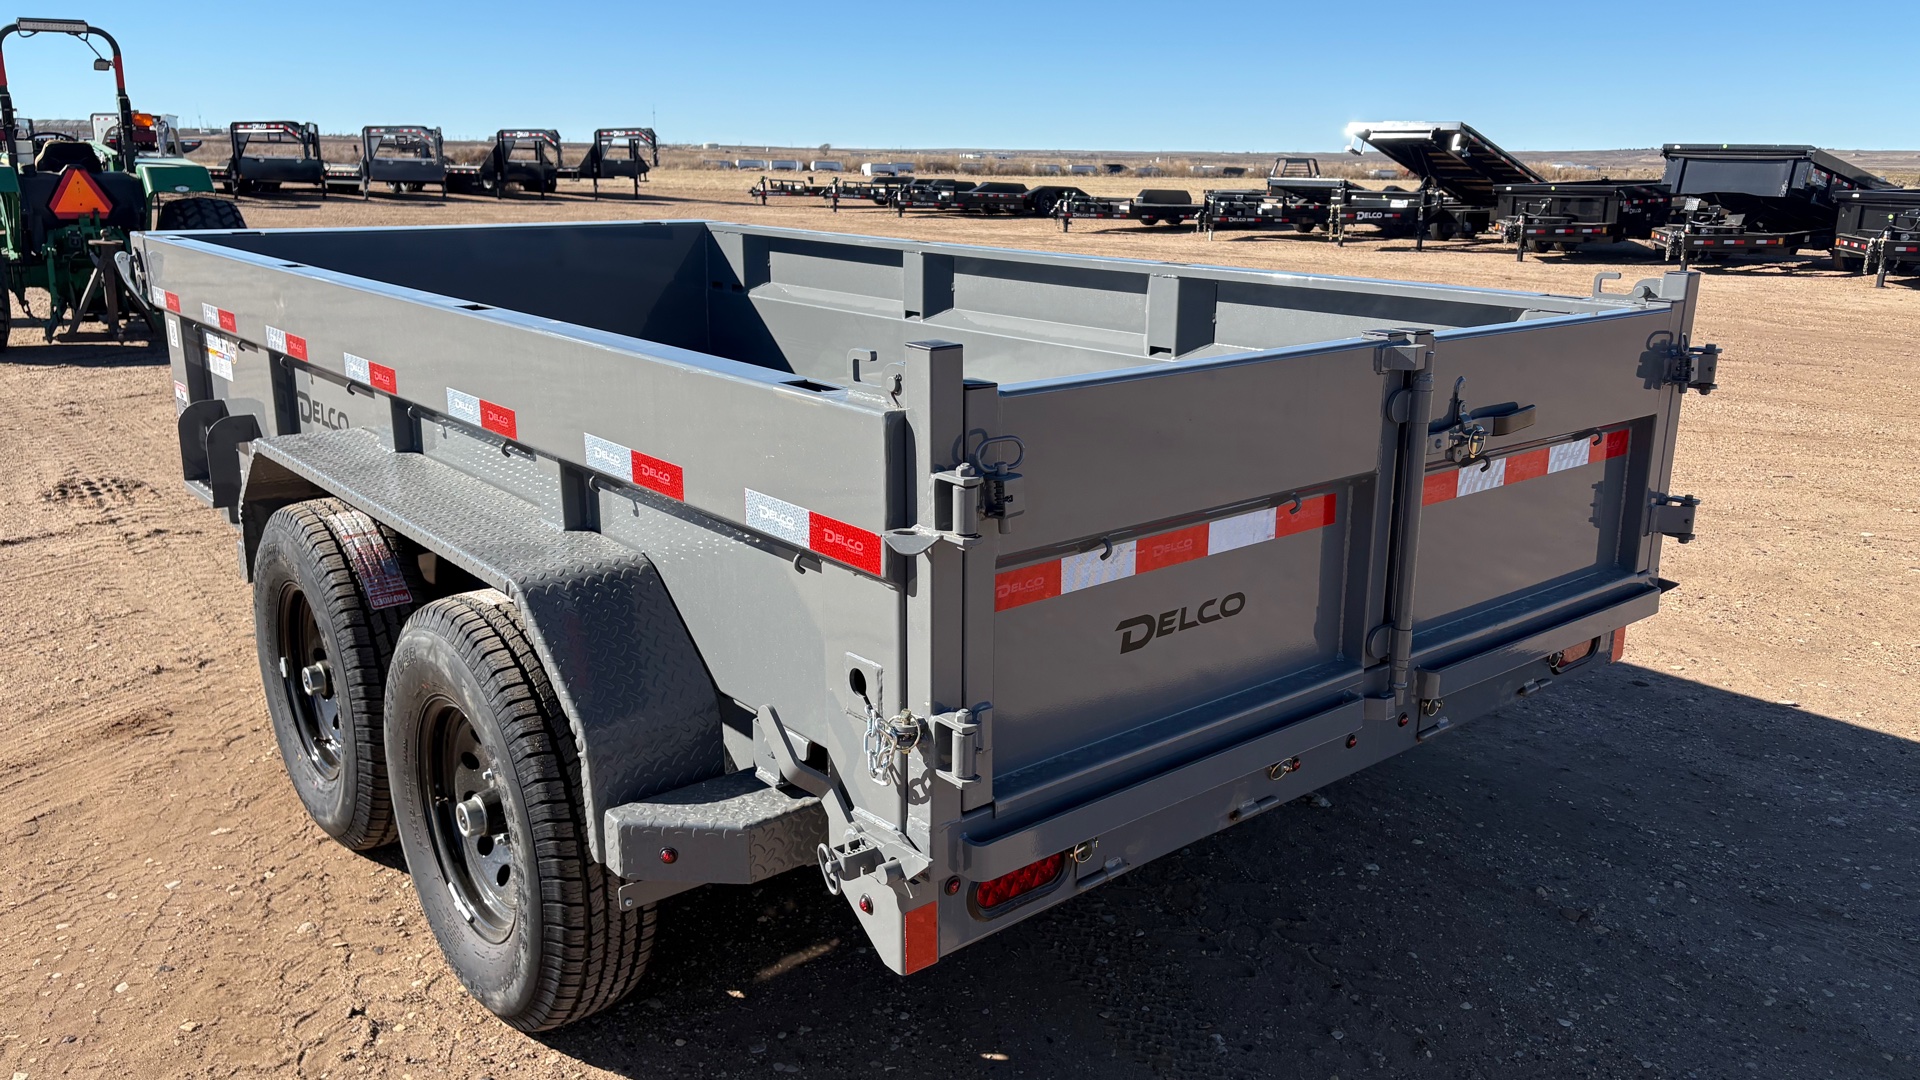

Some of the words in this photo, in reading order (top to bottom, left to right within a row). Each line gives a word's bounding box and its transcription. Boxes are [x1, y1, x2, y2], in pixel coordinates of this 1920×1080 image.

[1356, 212, 1382, 220] DELCO
[374, 372, 390, 384] DELCO
[454, 399, 474, 413] DELCO
[488, 411, 509, 425] DELCO
[594, 446, 621, 465] DELCO
[640, 464, 670, 482] DELCO
[758, 504, 794, 526] DELCO
[823, 528, 864, 552] DELCO
[1152, 538, 1193, 558] DELCO
[996, 577, 1044, 598] DELCO
[1115, 592, 1246, 654] DELCO
